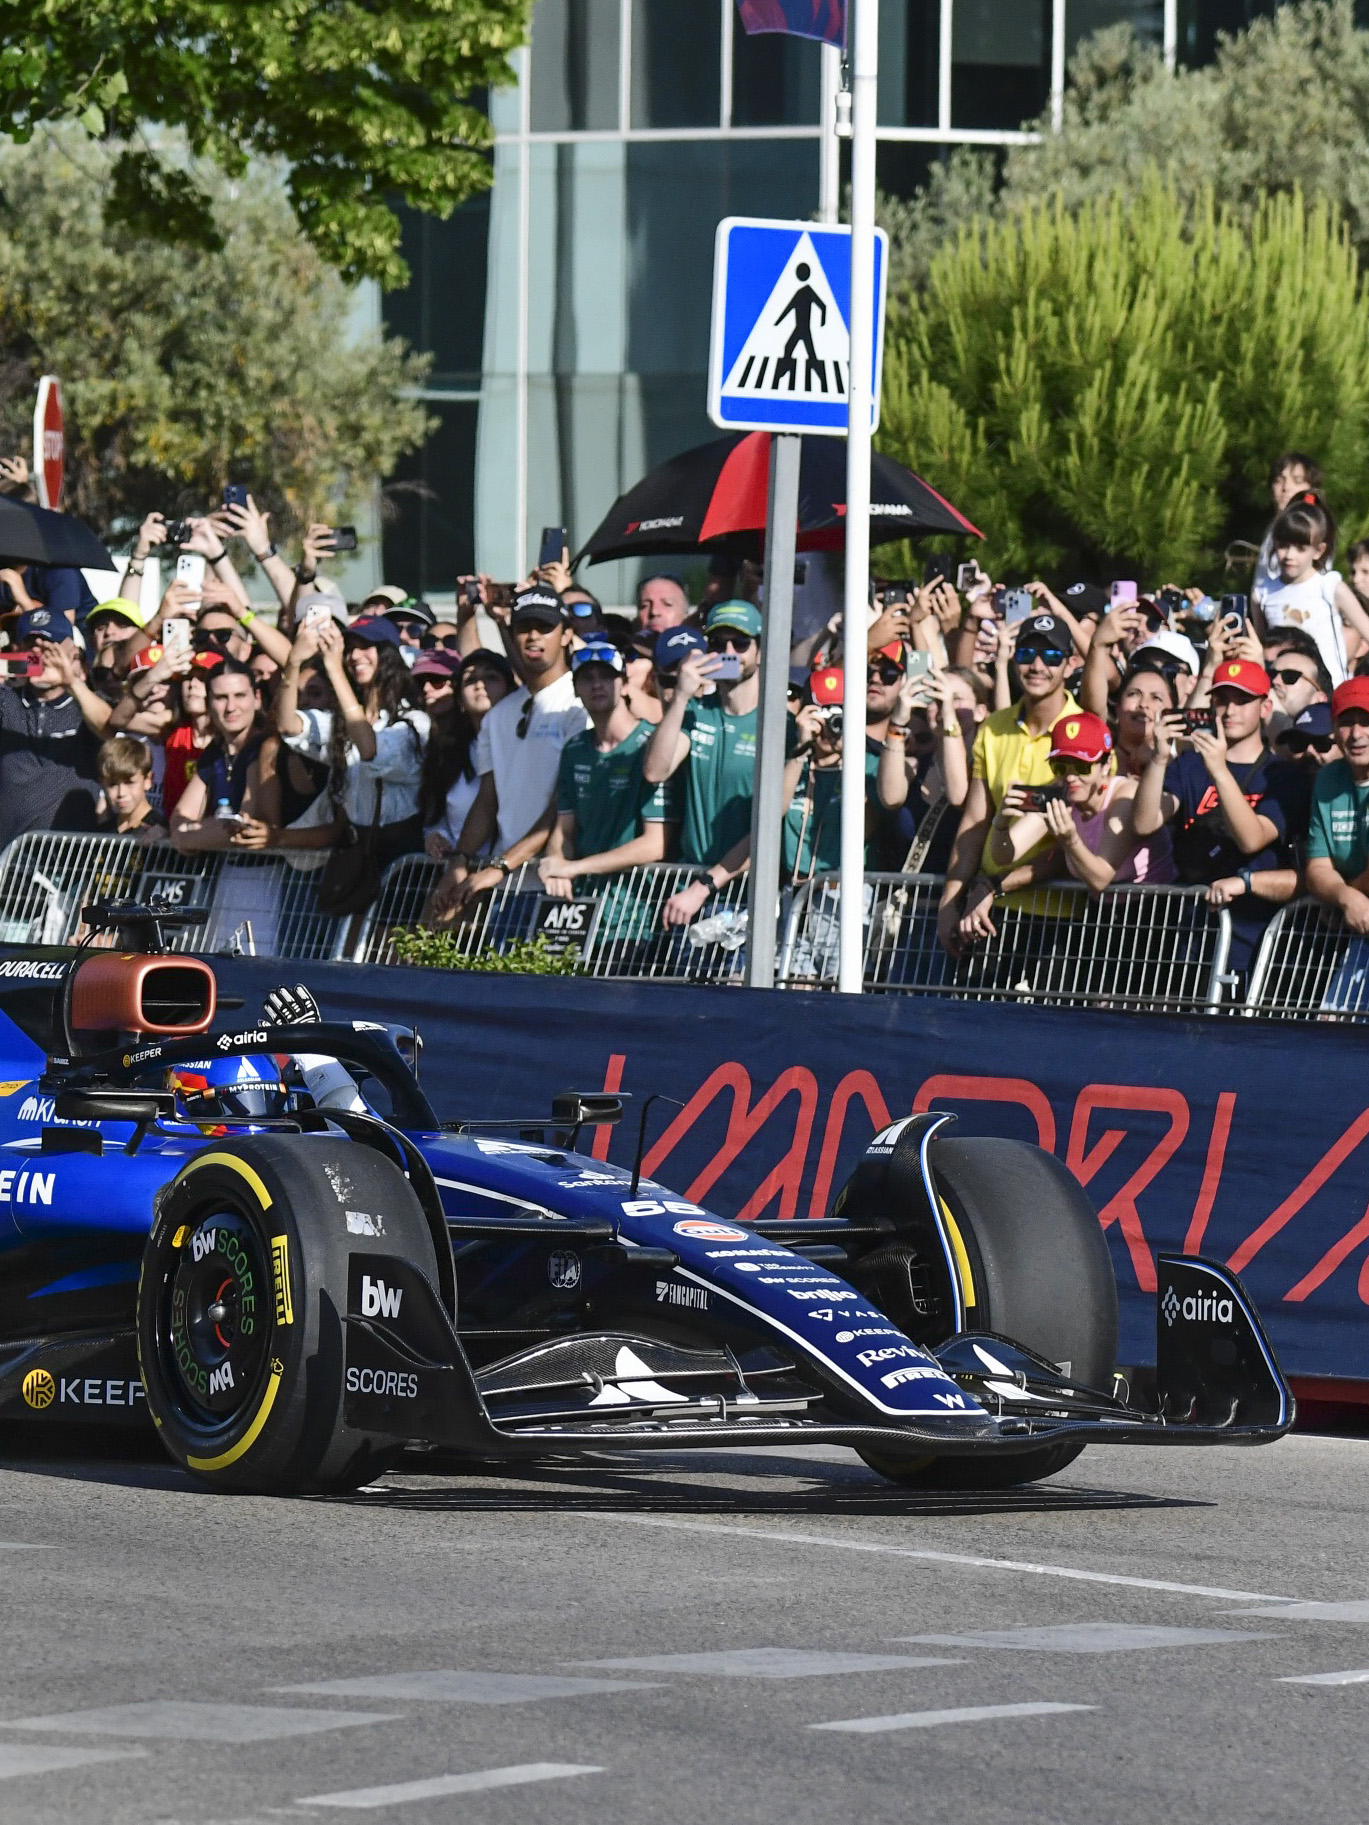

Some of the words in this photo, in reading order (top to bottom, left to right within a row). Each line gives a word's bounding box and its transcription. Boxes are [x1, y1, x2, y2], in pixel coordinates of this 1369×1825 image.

[543, 903, 587, 929] AMS
[233, 1030, 267, 1045] airia
[130, 1047, 162, 1064] KEEPER
[228, 1083, 278, 1093] MYPROTEIN
[620, 1200, 707, 1217] 55
[271, 1234, 294, 1326] PIRELLI
[362, 1275, 403, 1319] bw
[668, 1283, 709, 1310] FANCAPITAL
[786, 1289, 858, 1301] brillio
[1182, 1289, 1233, 1323] airia
[60, 1378, 146, 1406] KEEP
[346, 1367, 418, 1398] SCORES
